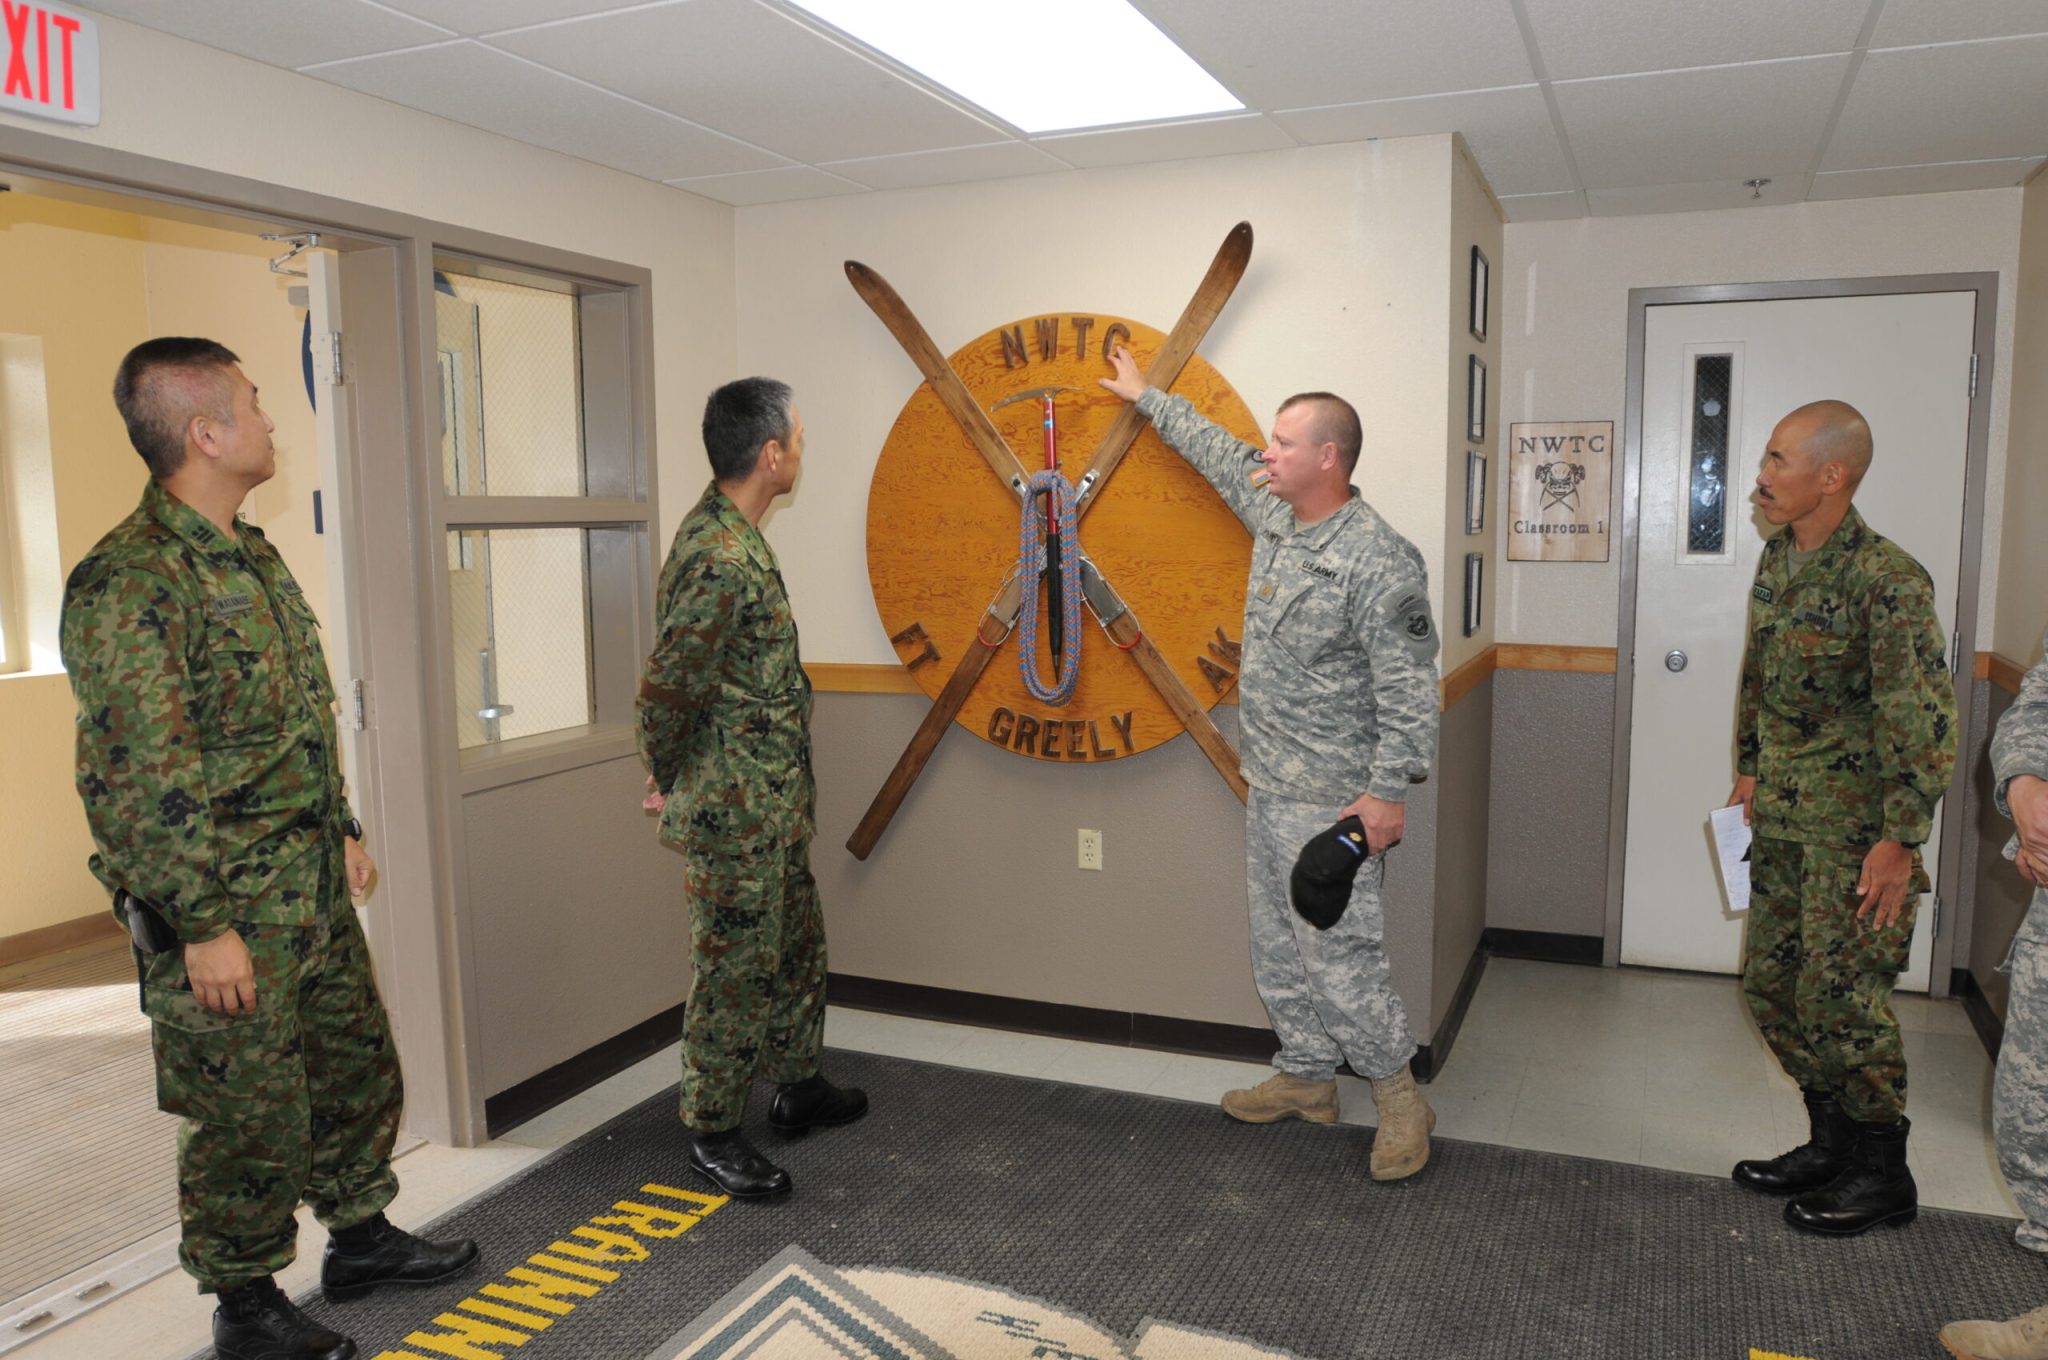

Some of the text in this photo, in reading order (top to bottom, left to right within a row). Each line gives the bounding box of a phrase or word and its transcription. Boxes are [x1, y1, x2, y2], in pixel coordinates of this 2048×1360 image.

[0, 0, 81, 110] XIT
[1000, 316, 1131, 368] NWTC
[1518, 435, 1605, 454] NWTC
[1514, 520, 1604, 535] Classroom 1
[891, 621, 942, 670] FT
[1197, 625, 1242, 692] AK
[987, 706, 1137, 759] GREELY
[371, 1182, 731, 1360] TRAININ
